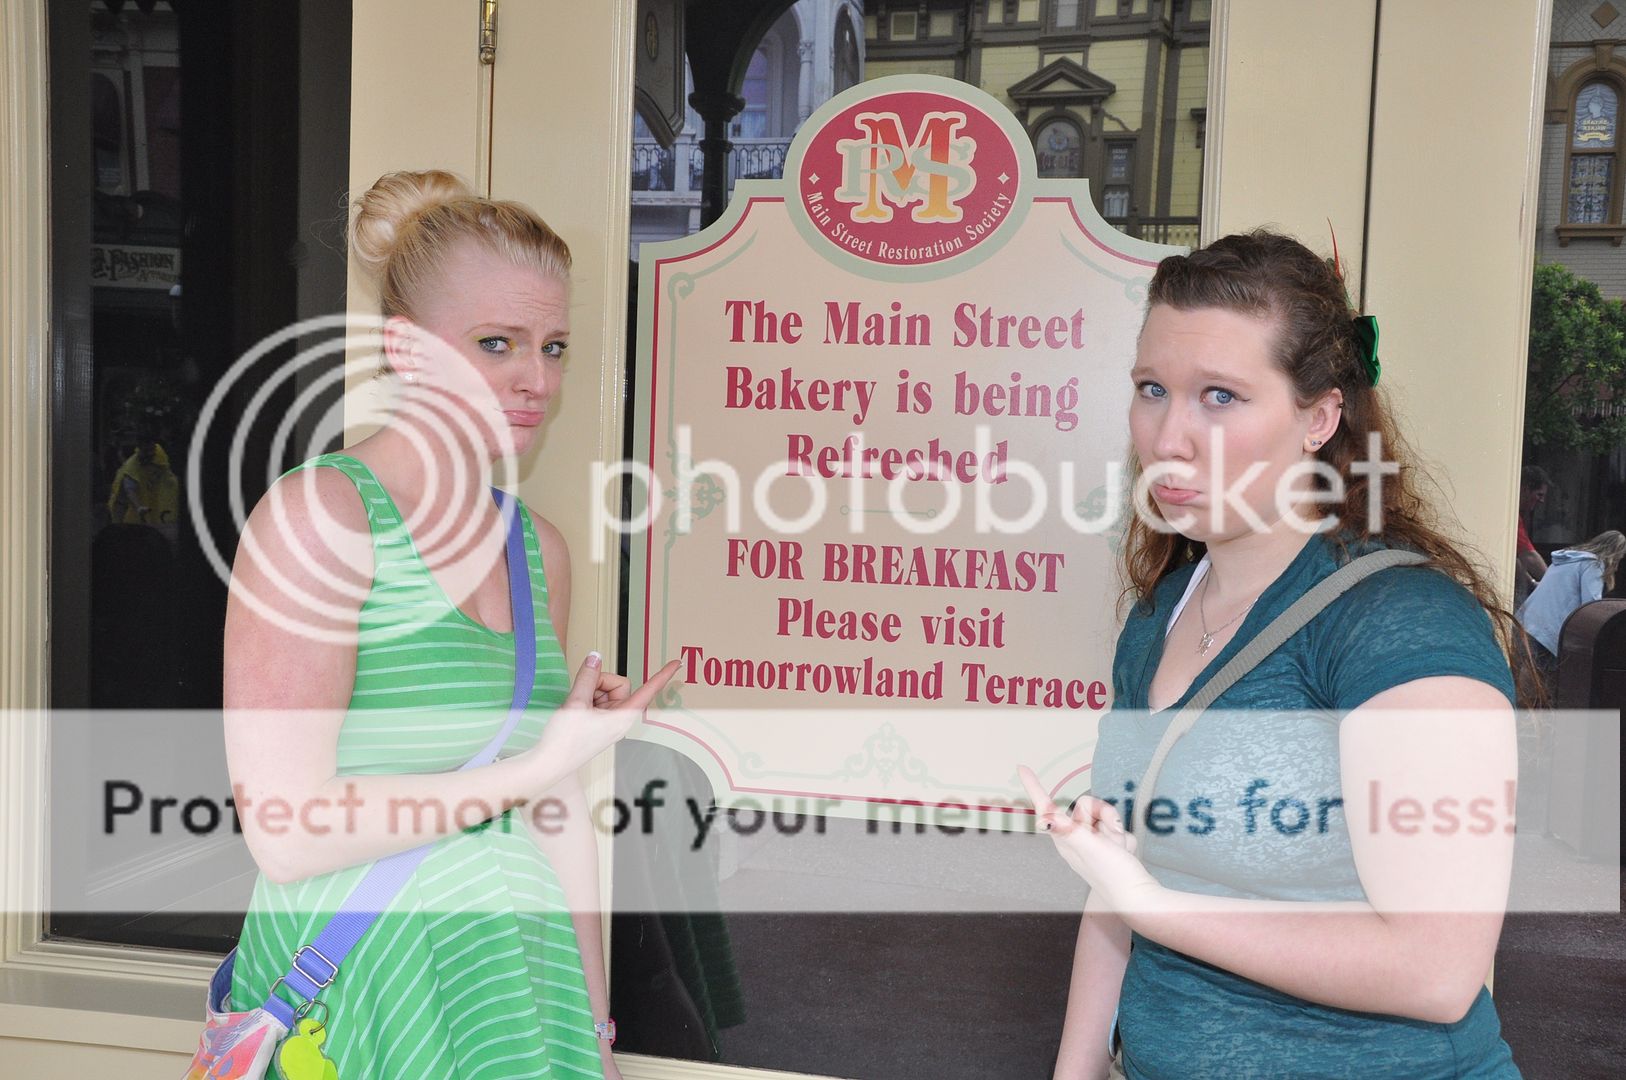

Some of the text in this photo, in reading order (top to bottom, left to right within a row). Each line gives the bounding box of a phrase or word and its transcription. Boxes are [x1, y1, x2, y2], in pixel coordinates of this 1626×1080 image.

[806, 190, 1013, 261] Main Street Restoration Society
[724, 299, 1086, 350] The Main Street
[725, 366, 1080, 432] Bakery is being
[786, 433, 1009, 485] Refreshed
[726, 538, 1065, 593] FOR BREAKFAST
[776, 597, 1006, 649] Please visit
[680, 645, 1108, 711] Tomorrowland Terrace
